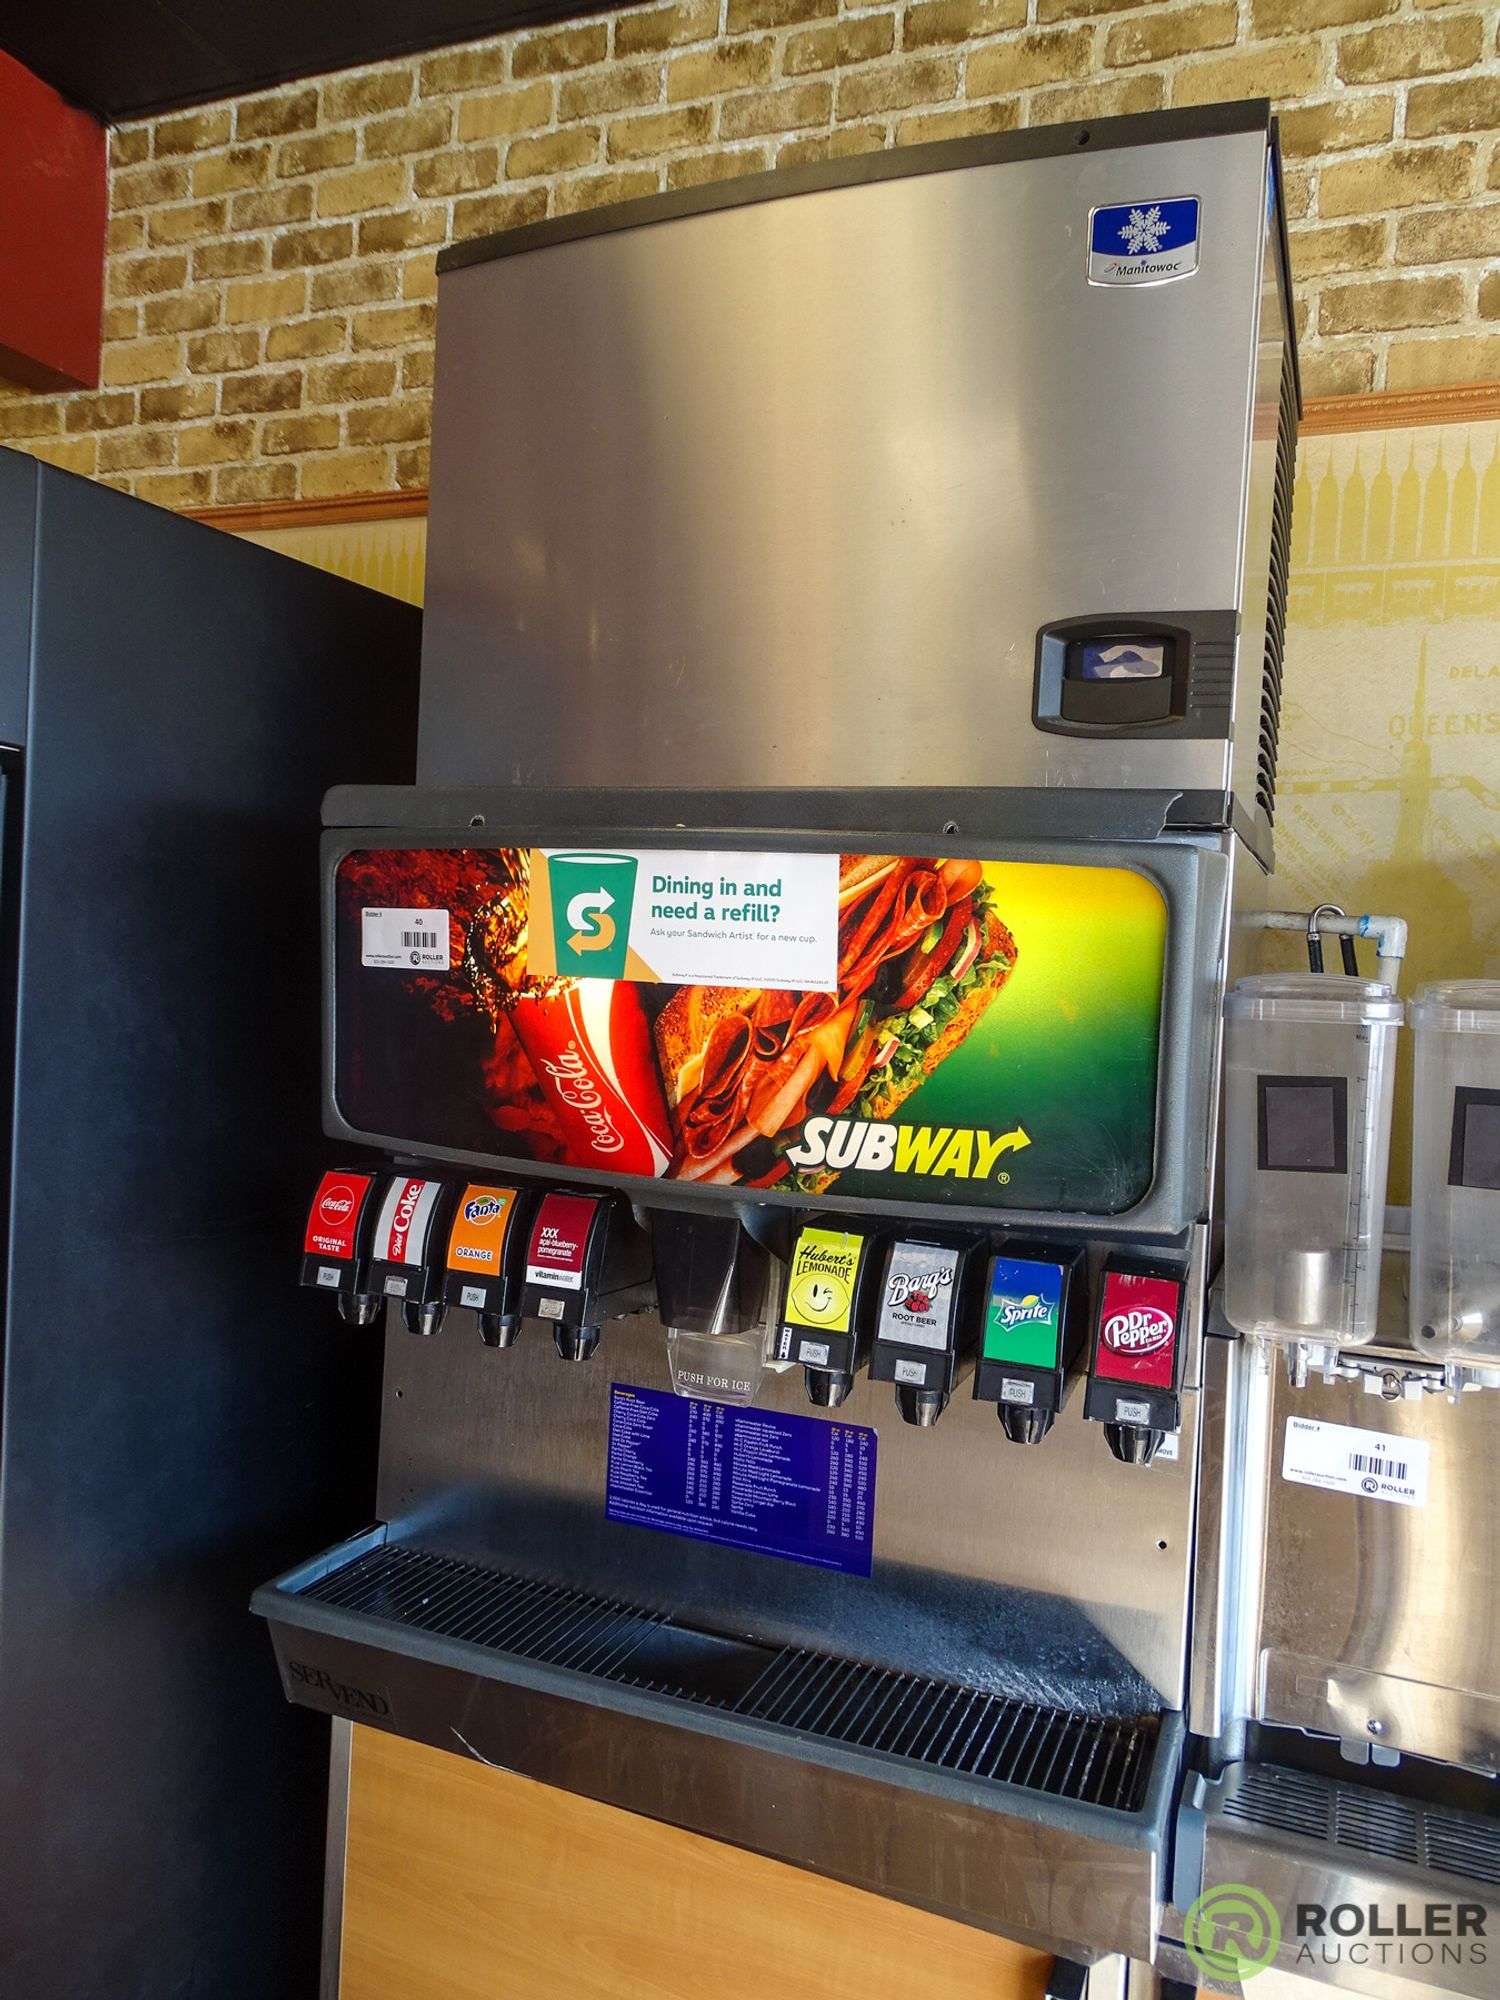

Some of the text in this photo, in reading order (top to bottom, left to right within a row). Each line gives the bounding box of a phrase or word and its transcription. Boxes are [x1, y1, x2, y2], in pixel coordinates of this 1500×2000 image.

[1116, 261, 1180, 276] Manitowoc
[652, 876, 782, 899] Dining in and
[651, 902, 780, 922] need a refill?
[650, 928, 665, 936] Ask
[667, 930, 685, 938] your
[687, 929, 727, 939] Sandwich
[757, 932, 770, 940] for
[799, 936, 817, 944] cup.
[540, 1050, 625, 1153] Coca-Cola
[786, 1117, 1032, 1179] SUBWAY
[393, 1184, 421, 1233] Coke
[464, 1200, 500, 1221] Fanta
[312, 1235, 347, 1247] ORIGINAL
[319, 1243, 341, 1252] TASTE
[456, 1246, 493, 1262] ORANGE
[799, 1245, 855, 1266] Hubert's
[796, 1260, 852, 1285] LEMONADE
[887, 1266, 953, 1307] Barq's
[892, 1312, 915, 1322] ROOT
[916, 1316, 937, 1326] BEER
[1001, 1304, 1048, 1326] Sprite
[1128, 1312, 1152, 1330] Dr
[1113, 1315, 1168, 1348] Pepper
[806, 1350, 822, 1358] PUSH
[678, 1370, 751, 1392] PUSH FOR ICE
[902, 1368, 918, 1376] PUSH
[1009, 1388, 1026, 1398] PUSH
[1124, 1406, 1141, 1416] PUSH
[1375, 1443, 1386, 1452] 41
[1381, 1483, 1415, 1496] ROLLER
